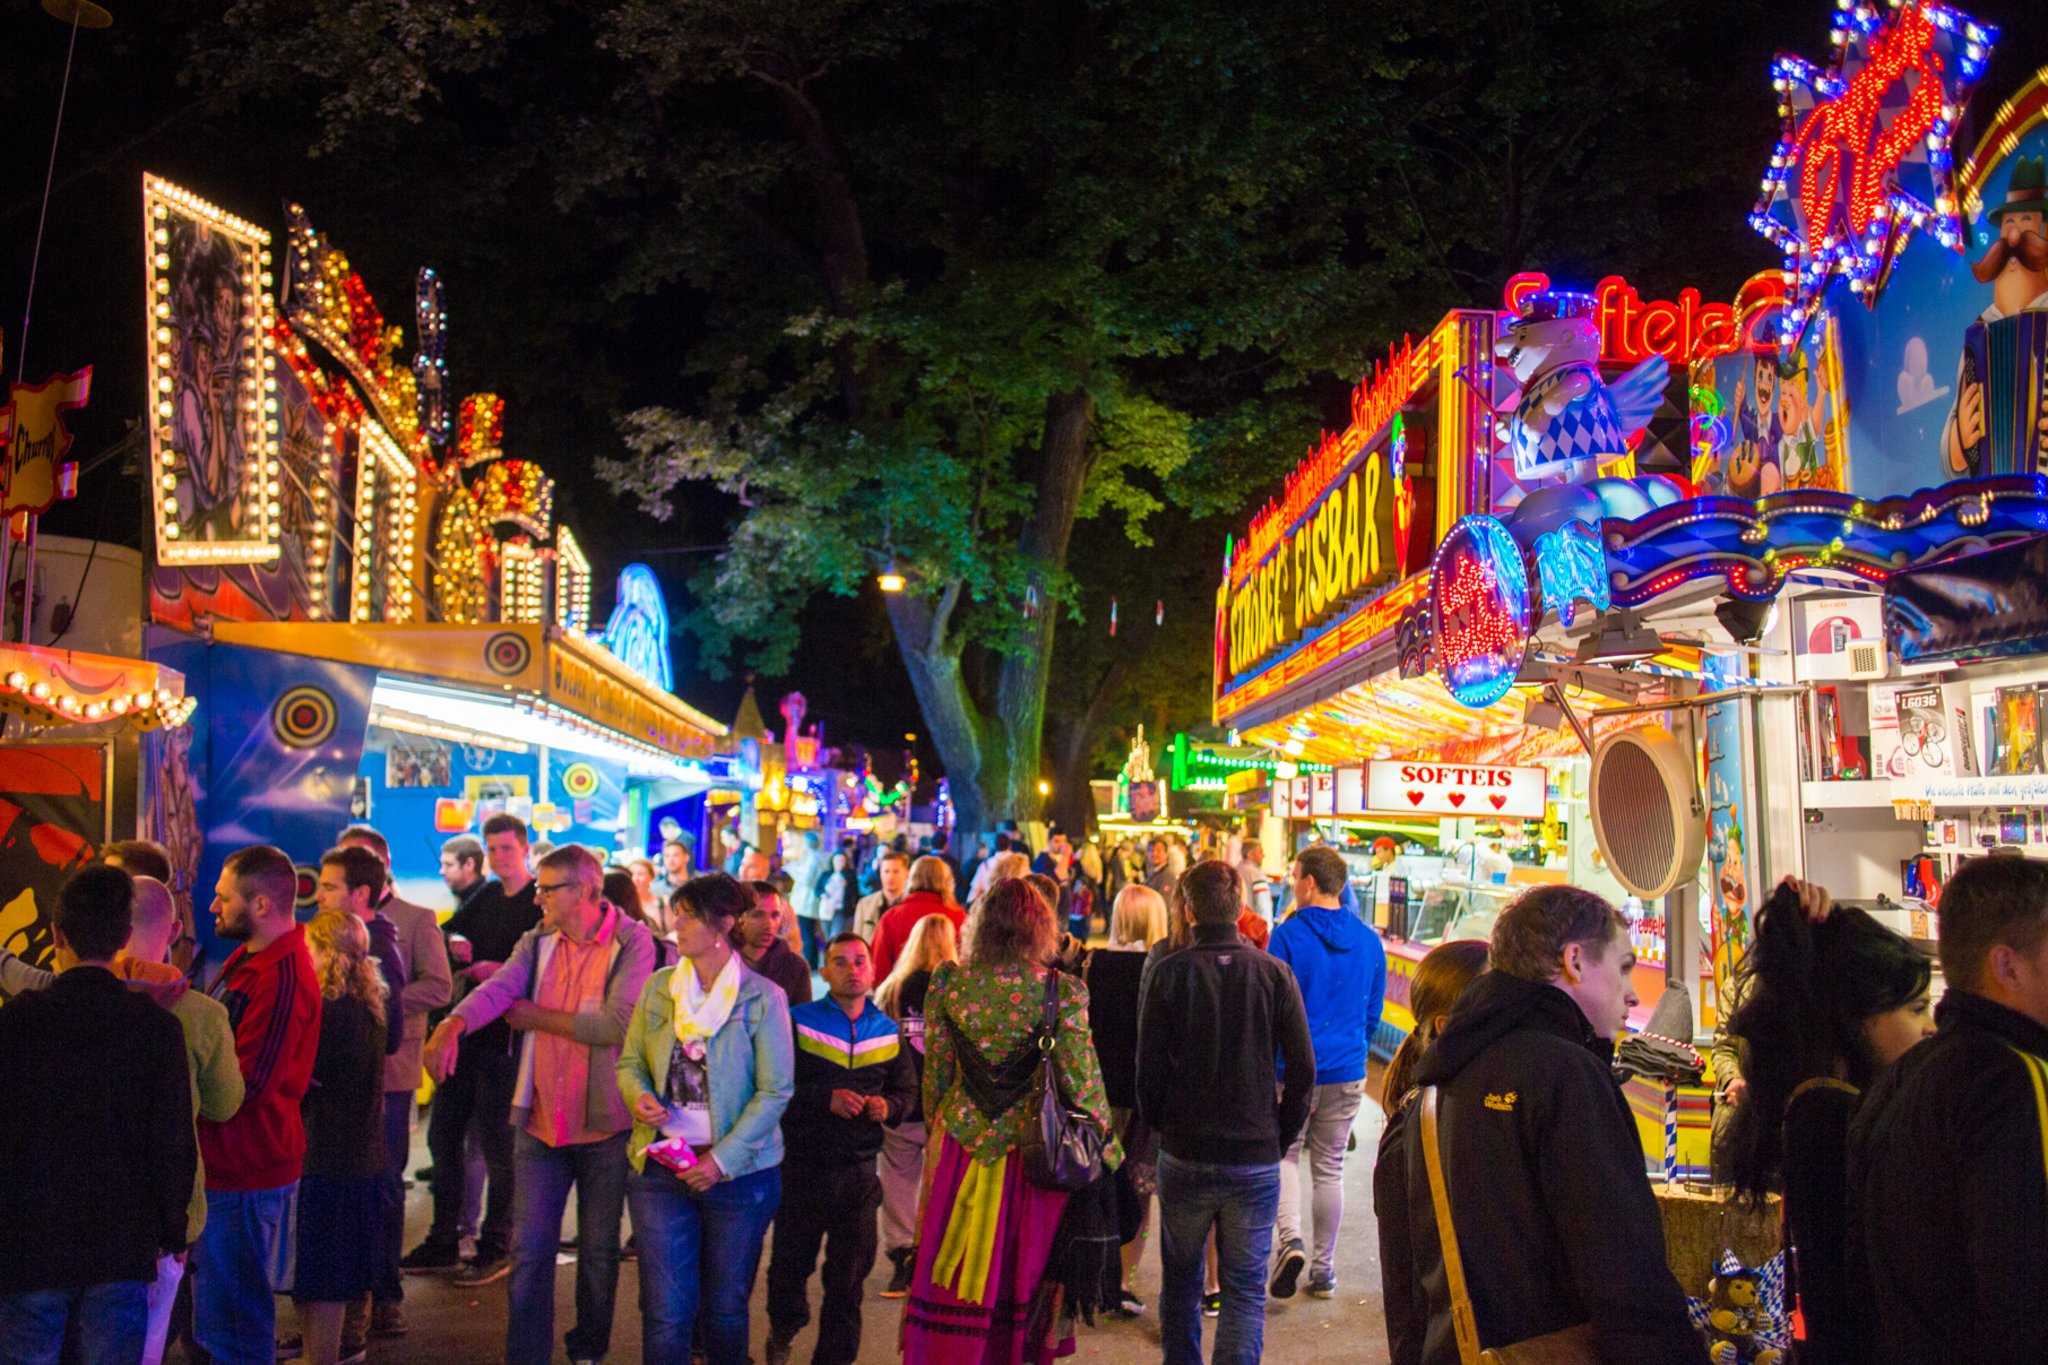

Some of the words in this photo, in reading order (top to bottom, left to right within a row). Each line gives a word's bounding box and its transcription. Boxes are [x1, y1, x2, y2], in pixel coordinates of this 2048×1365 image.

[1295, 451, 1380, 629] EISBAR
[1901, 695, 1937, 710] L6036
[1401, 766, 1512, 787] SOFTEIS
